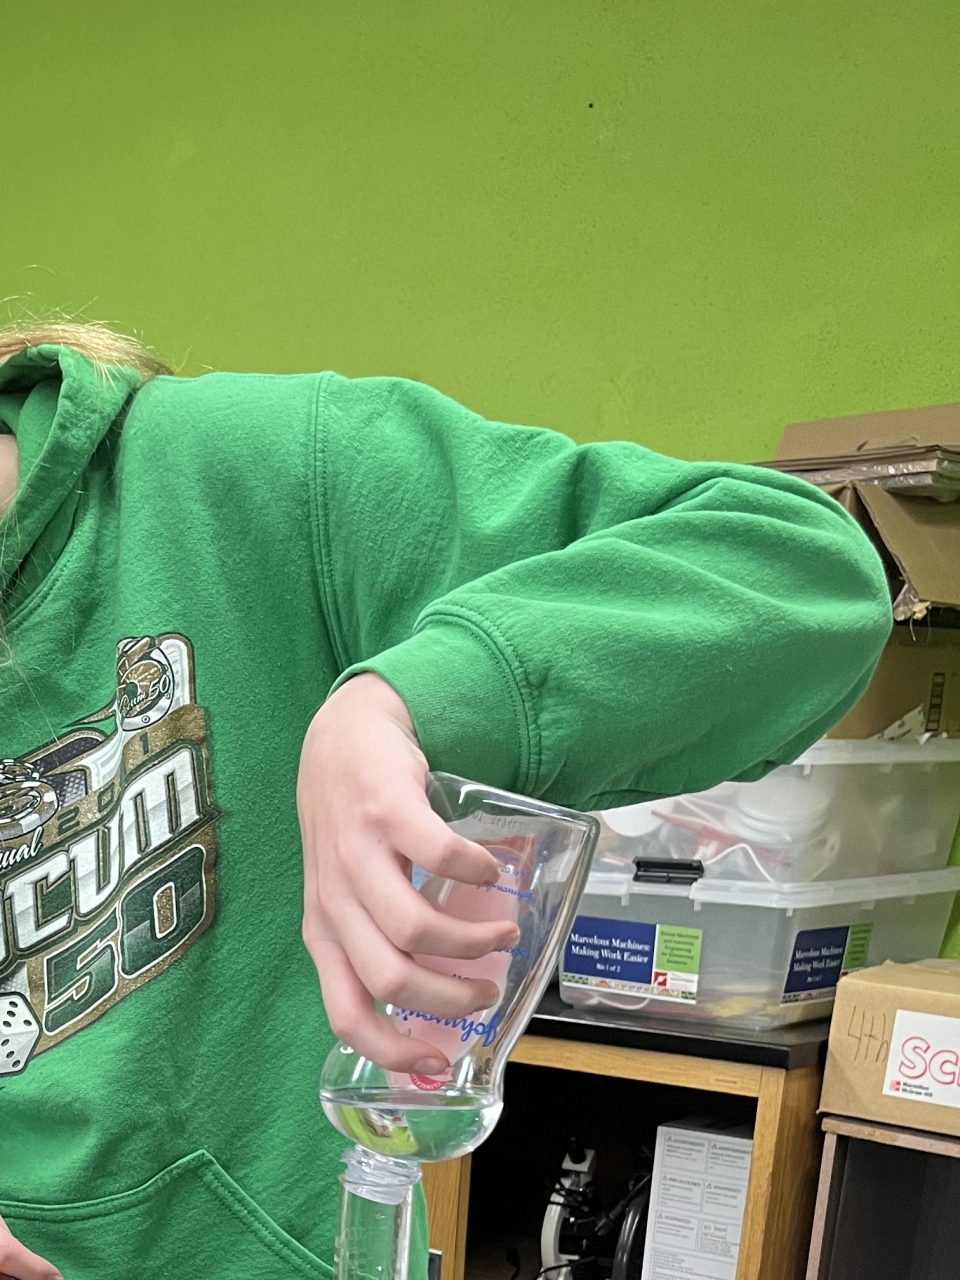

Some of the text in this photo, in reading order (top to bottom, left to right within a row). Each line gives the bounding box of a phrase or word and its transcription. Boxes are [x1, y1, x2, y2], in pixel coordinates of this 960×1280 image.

[42, 846, 207, 1035] 50
[570, 932, 610, 947] Marvelous
[611, 938, 652, 952] Machines:
[571, 944, 649, 965] Making Work Easier
[898, 1036, 960, 1089] Sc
